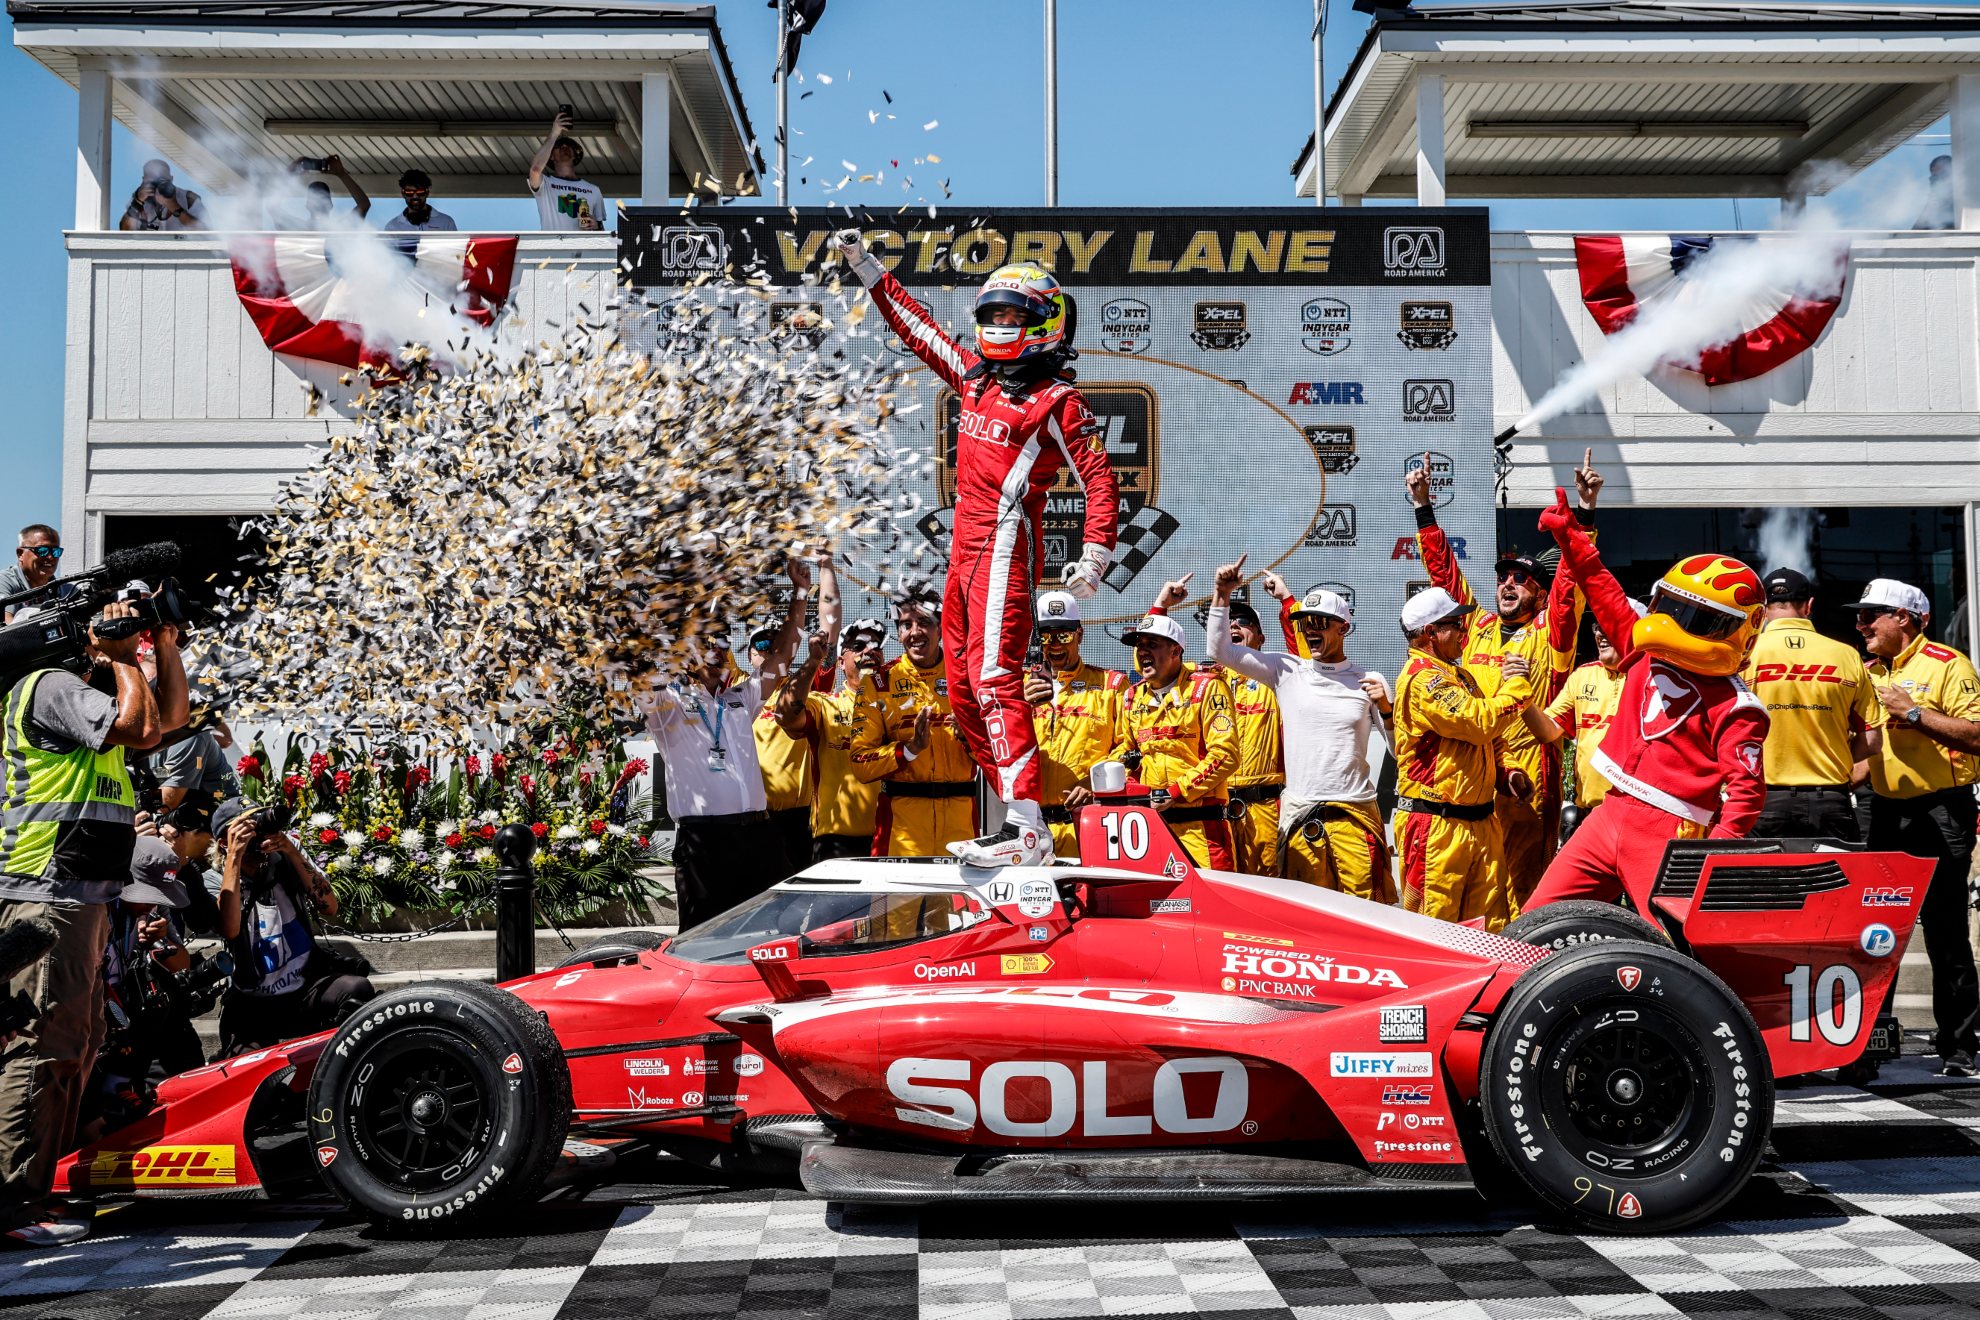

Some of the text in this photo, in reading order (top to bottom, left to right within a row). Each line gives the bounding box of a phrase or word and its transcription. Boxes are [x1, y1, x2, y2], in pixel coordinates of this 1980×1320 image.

[1129, 231, 1336, 273] LANE
[1384, 269, 1446, 277] ROAD AMERICA
[988, 281, 1020, 290] SOLO
[1124, 309, 1146, 318] NTT
[1204, 307, 1242, 319] XPEL
[1323, 308, 1346, 318] NTT
[1410, 306, 1448, 319] XPEL
[1102, 324, 1150, 333] INDYCAR
[1302, 323, 1350, 332] INDYCAR
[1288, 382, 1364, 405] AMR
[958, 409, 1011, 444] SOLO
[1391, 536, 1467, 560] AR
[39, 617, 59, 626] SONY
[1756, 663, 1843, 683] DHL
[891, 691, 919, 699] HONDA
[1606, 768, 1650, 797] FIREHAWK
[1101, 811, 1149, 861] 10
[1862, 887, 1913, 903] HRC
[1158, 900, 1190, 908] GANASSI
[752, 947, 787, 960] SOLO
[1223, 944, 1336, 964] POWERED by
[914, 961, 976, 981] OpenAI
[1221, 952, 1409, 989] HONDA
[1239, 978, 1316, 997] PNC BANK
[1783, 963, 1864, 1046] 10
[1380, 1009, 1424, 1024] TRENCH
[335, 1000, 435, 1059] Firestone
[1380, 1023, 1424, 1037] SHORING
[625, 1060, 662, 1068] LINCOLN
[736, 1061, 761, 1069] eurol
[1397, 1062, 1429, 1073] mixes
[886, 1056, 1249, 1137] SOLO
[1381, 1084, 1433, 1101] HRC
[1505, 1022, 1544, 1162] Firestone
[1711, 1021, 1752, 1162] Firestone
[646, 1097, 674, 1105] Roboze
[1422, 1116, 1445, 1126] NTT
[1373, 1140, 1452, 1153] Firestone
[1644, 1138, 1690, 1168] RACING
[109, 1152, 218, 1178] DHL
[402, 1164, 505, 1221] Firestone
